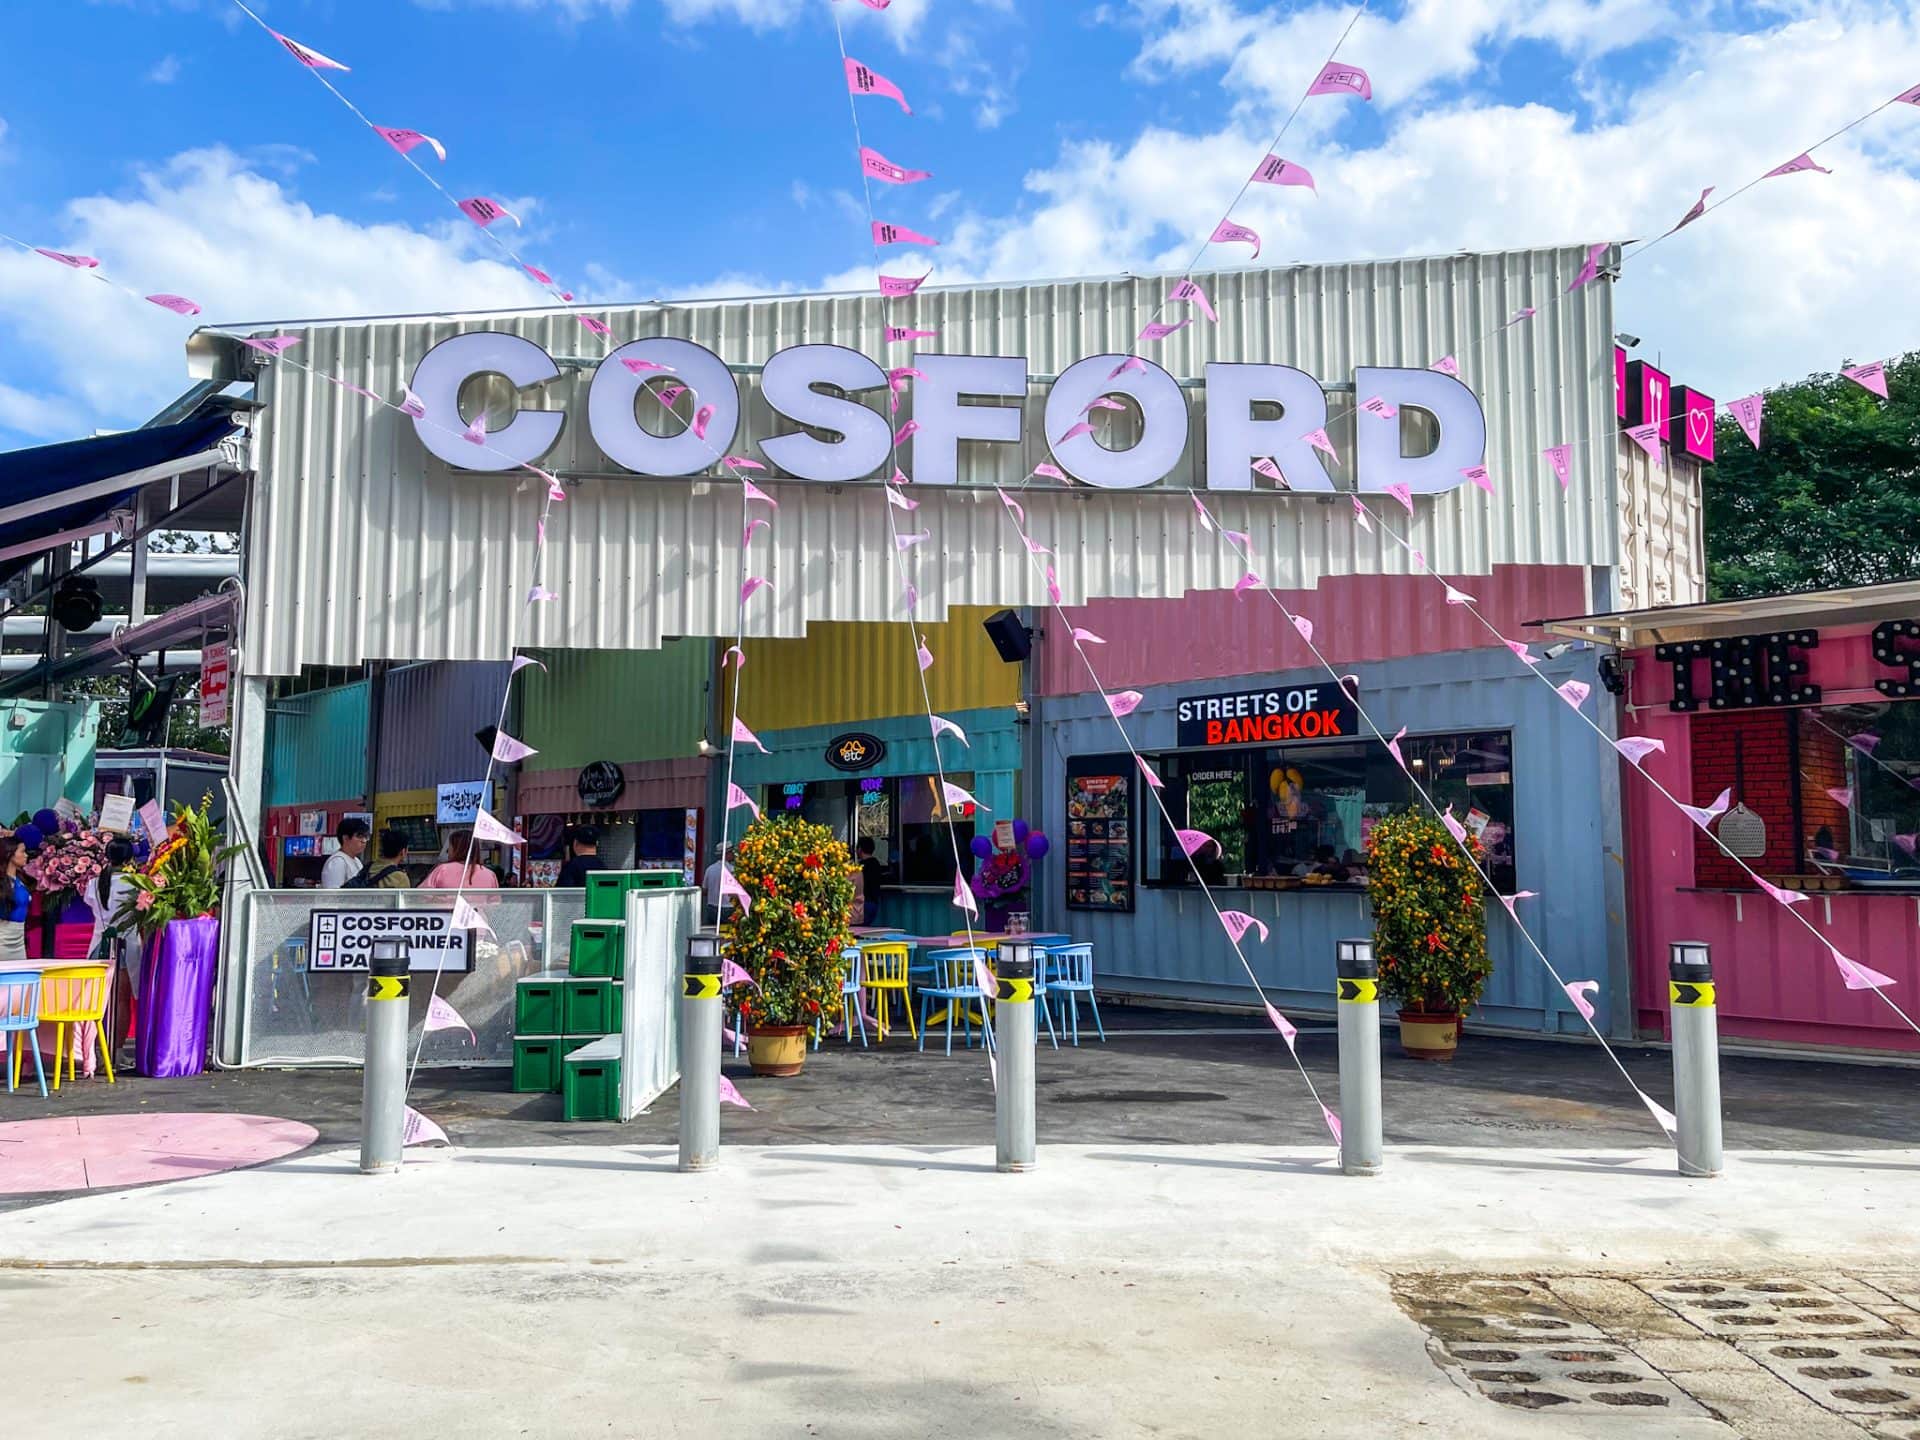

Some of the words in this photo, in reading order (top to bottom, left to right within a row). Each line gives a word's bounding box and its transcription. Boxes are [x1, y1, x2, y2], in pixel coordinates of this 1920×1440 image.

[411, 331, 1487, 494] COSFORD
[1656, 630, 1821, 712] THE
[1179, 693, 1279, 721] STREETS
[1287, 689, 1317, 710] OF
[1207, 709, 1341, 744] BANGKOK
[844, 751, 862, 761] etc
[1192, 772, 1214, 780] ORDER
[1216, 770, 1232, 779] HERE
[342, 917, 443, 930] COSFORD
